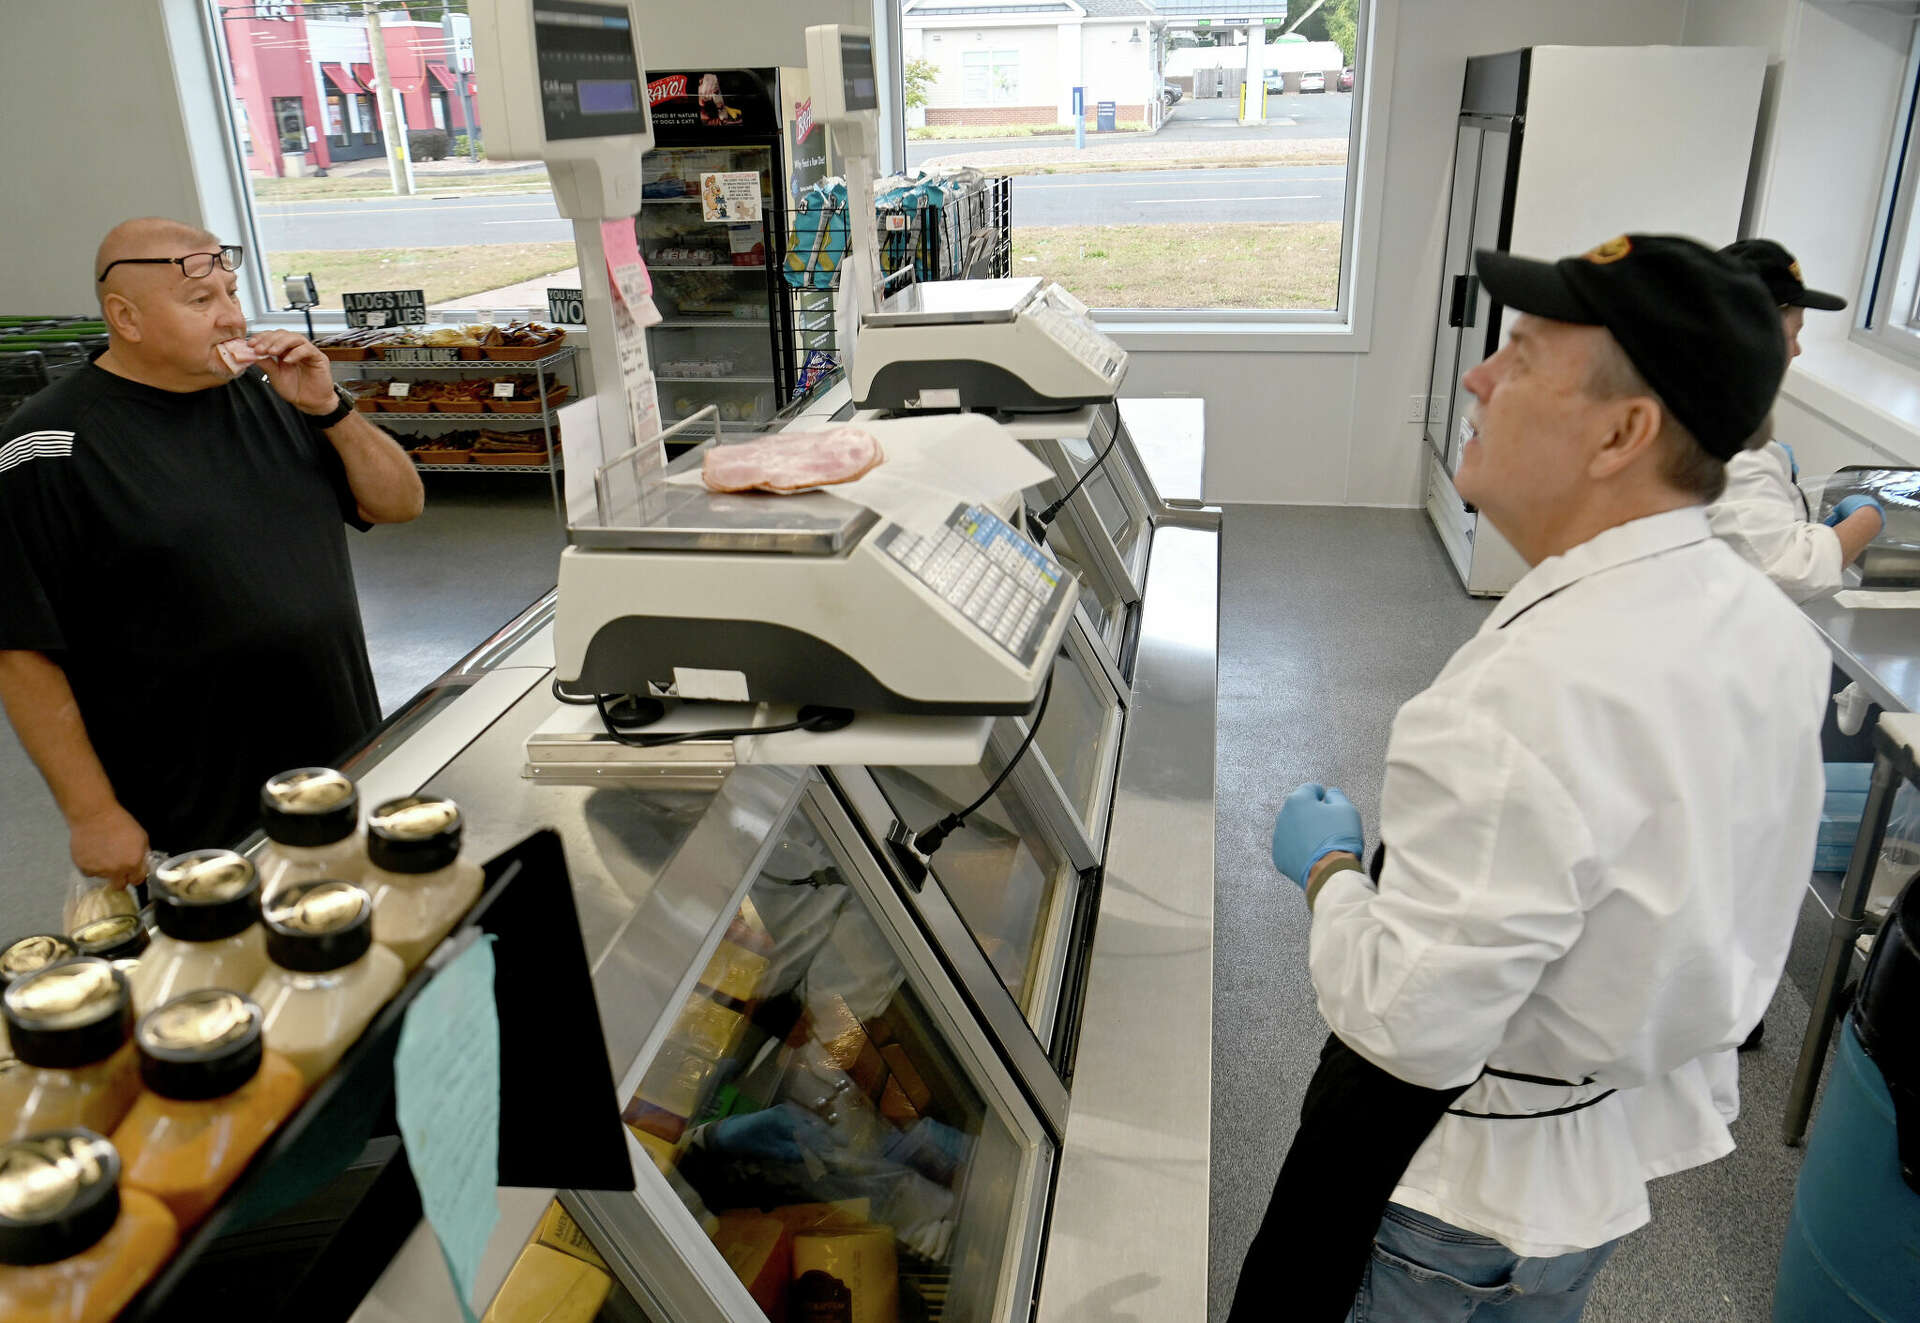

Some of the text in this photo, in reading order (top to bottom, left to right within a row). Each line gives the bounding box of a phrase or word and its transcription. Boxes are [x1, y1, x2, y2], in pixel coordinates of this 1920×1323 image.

[647, 79, 684, 102] RAVO!
[345, 291, 423, 310] A DOG'S TAIL
[549, 290, 565, 300] YOU
[395, 308, 425, 325] LIES
[549, 300, 584, 324] WO
